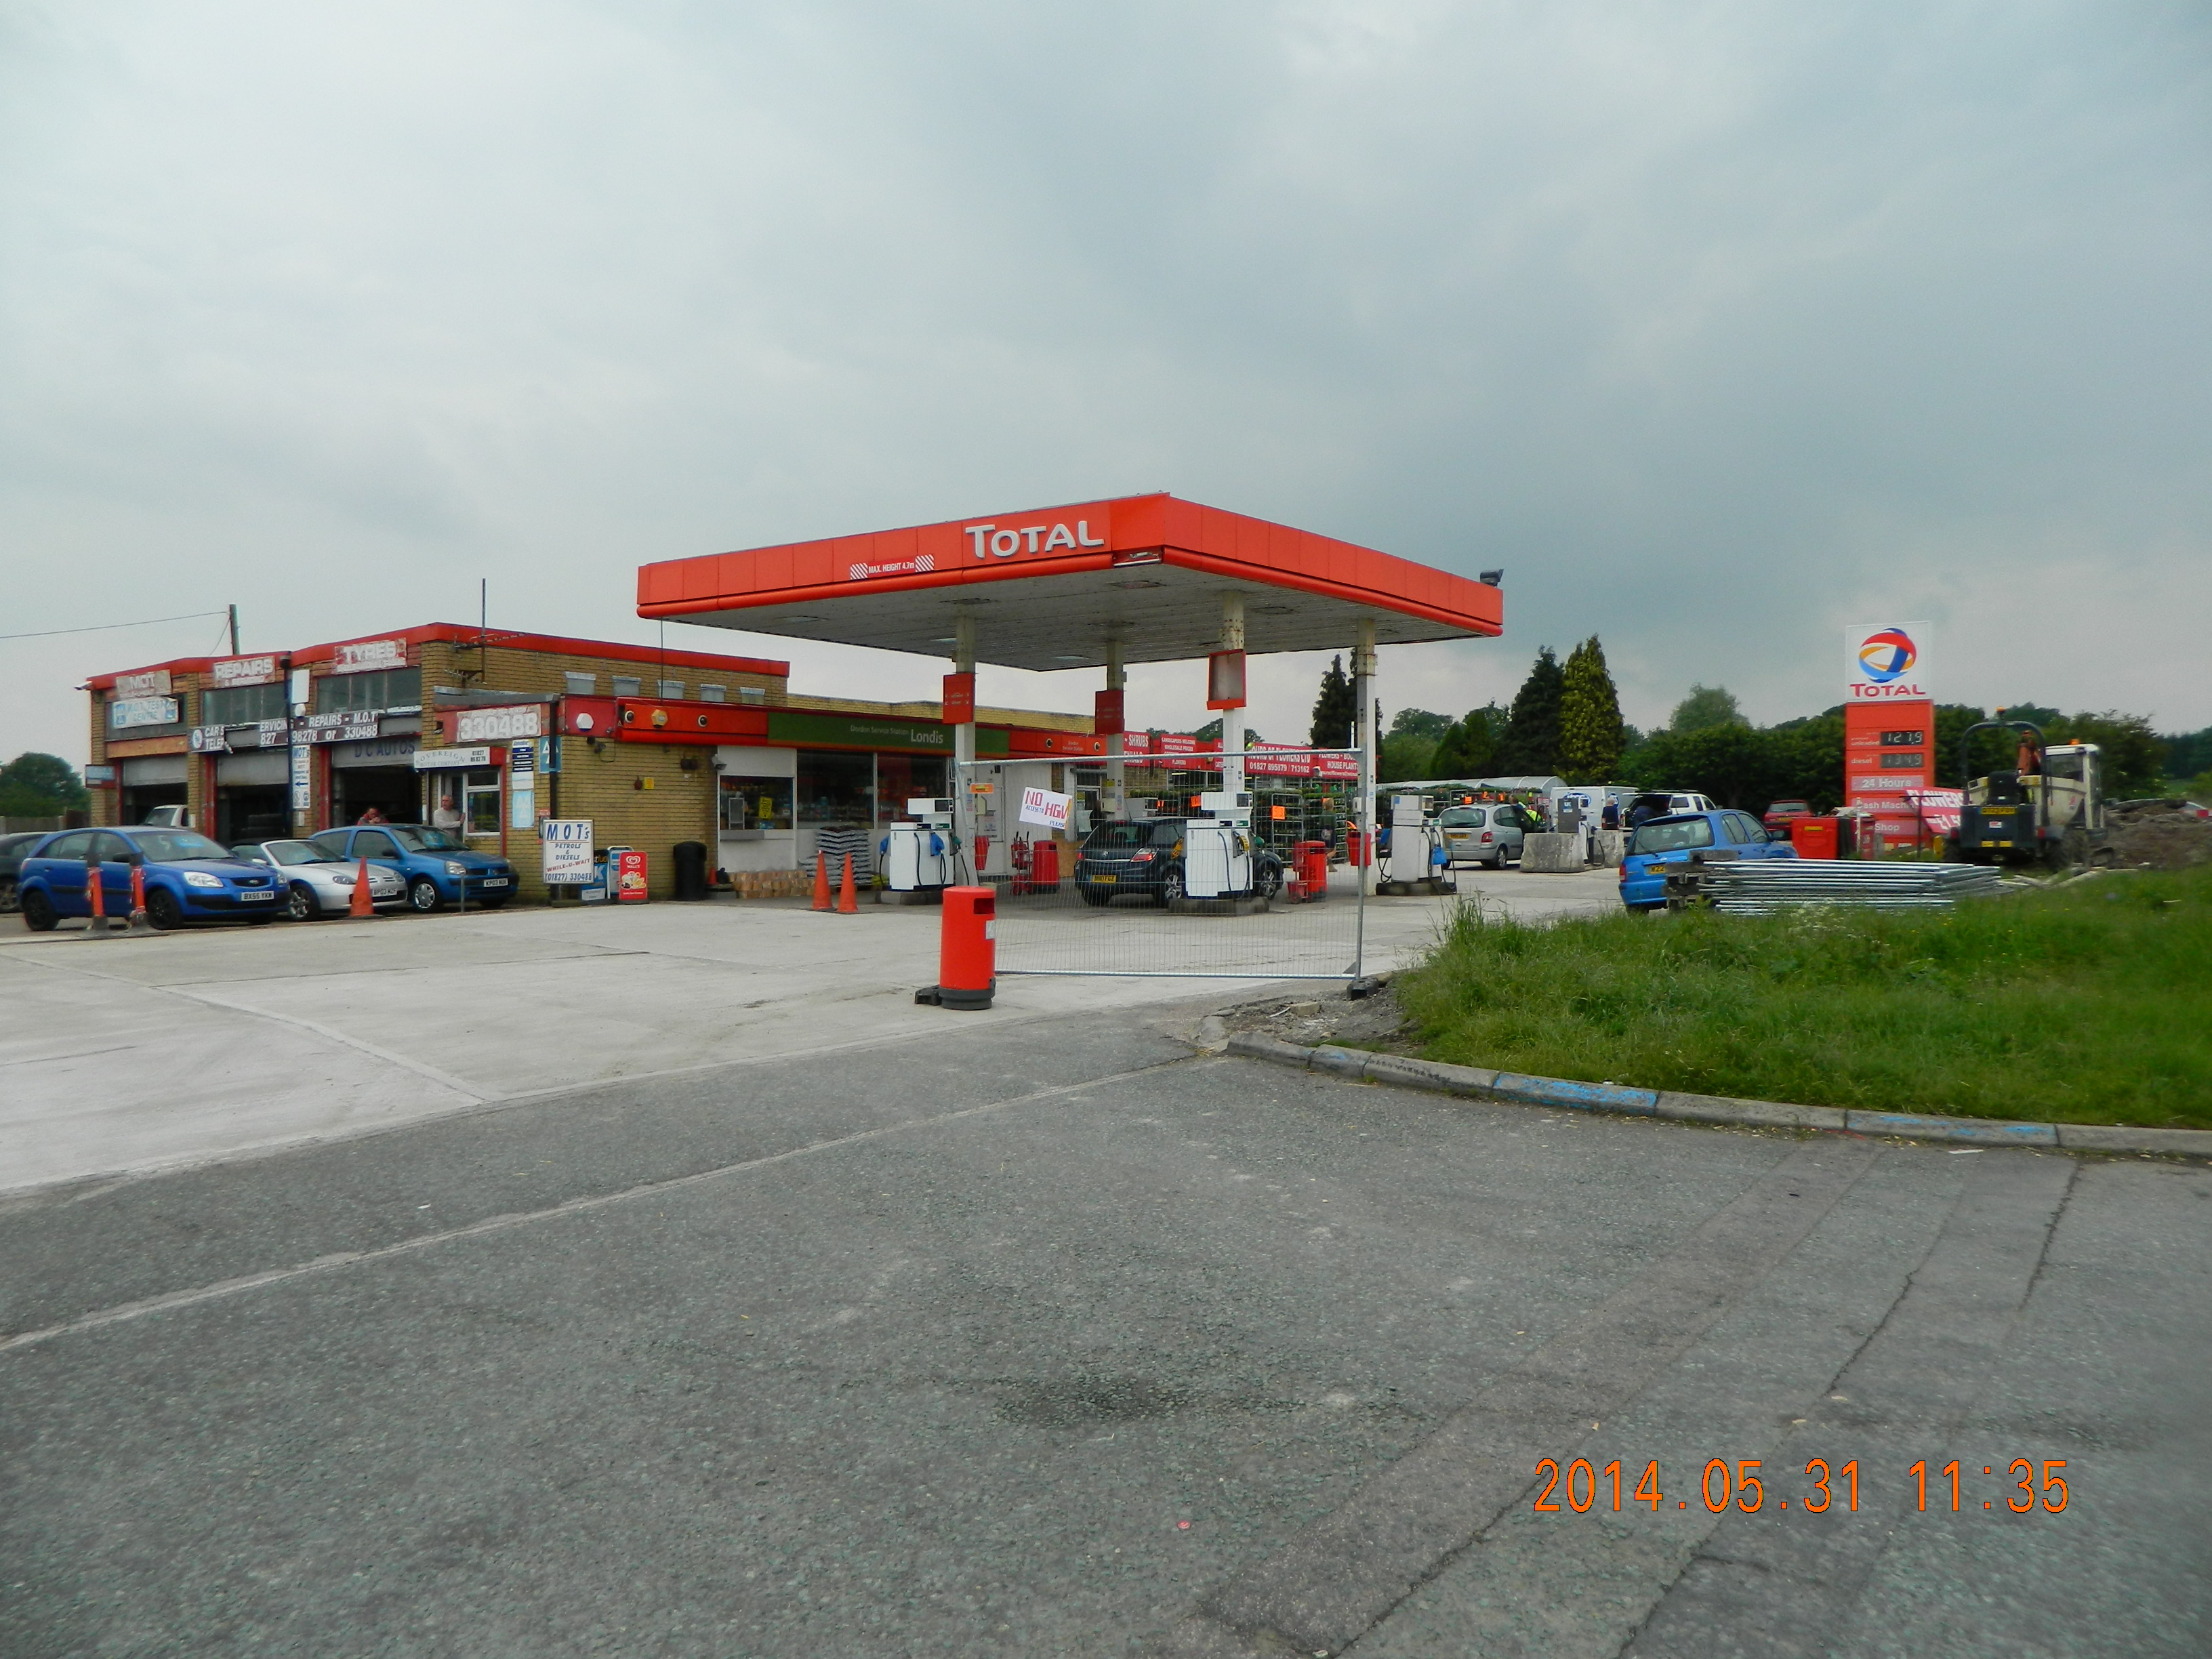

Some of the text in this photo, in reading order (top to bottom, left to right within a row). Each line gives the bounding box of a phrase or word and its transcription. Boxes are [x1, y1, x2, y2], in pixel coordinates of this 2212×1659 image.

[966, 520, 1105, 558] TOTAL
[868, 561, 915, 574] MAX. HEIGHT 4.7m
[1849, 683, 1926, 697] TOTAL
[309, 714, 342, 728] REPAIRS
[459, 712, 539, 741] 330488
[326, 730, 337, 740] or
[344, 724, 378, 739] 330488
[911, 729, 943, 743] Londis
[1129, 735, 1149, 747] SHRUBS
[415, 750, 465, 764] SOVEREIGN
[1249, 762, 1266, 771] 01827
[1291, 764, 1310, 773] 713162
[1327, 761, 1343, 769] HOUSE
[1862, 777, 1912, 788] 24 Hours
[1025, 790, 1044, 806] NO
[1906, 790, 1964, 808] FLOWERS
[1875, 823, 1900, 834] Shop
[546, 858, 591, 872] WHILE-U-WAIT
[545, 872, 592, 882] (01827) 330488
[244, 892, 260, 900] BX55
